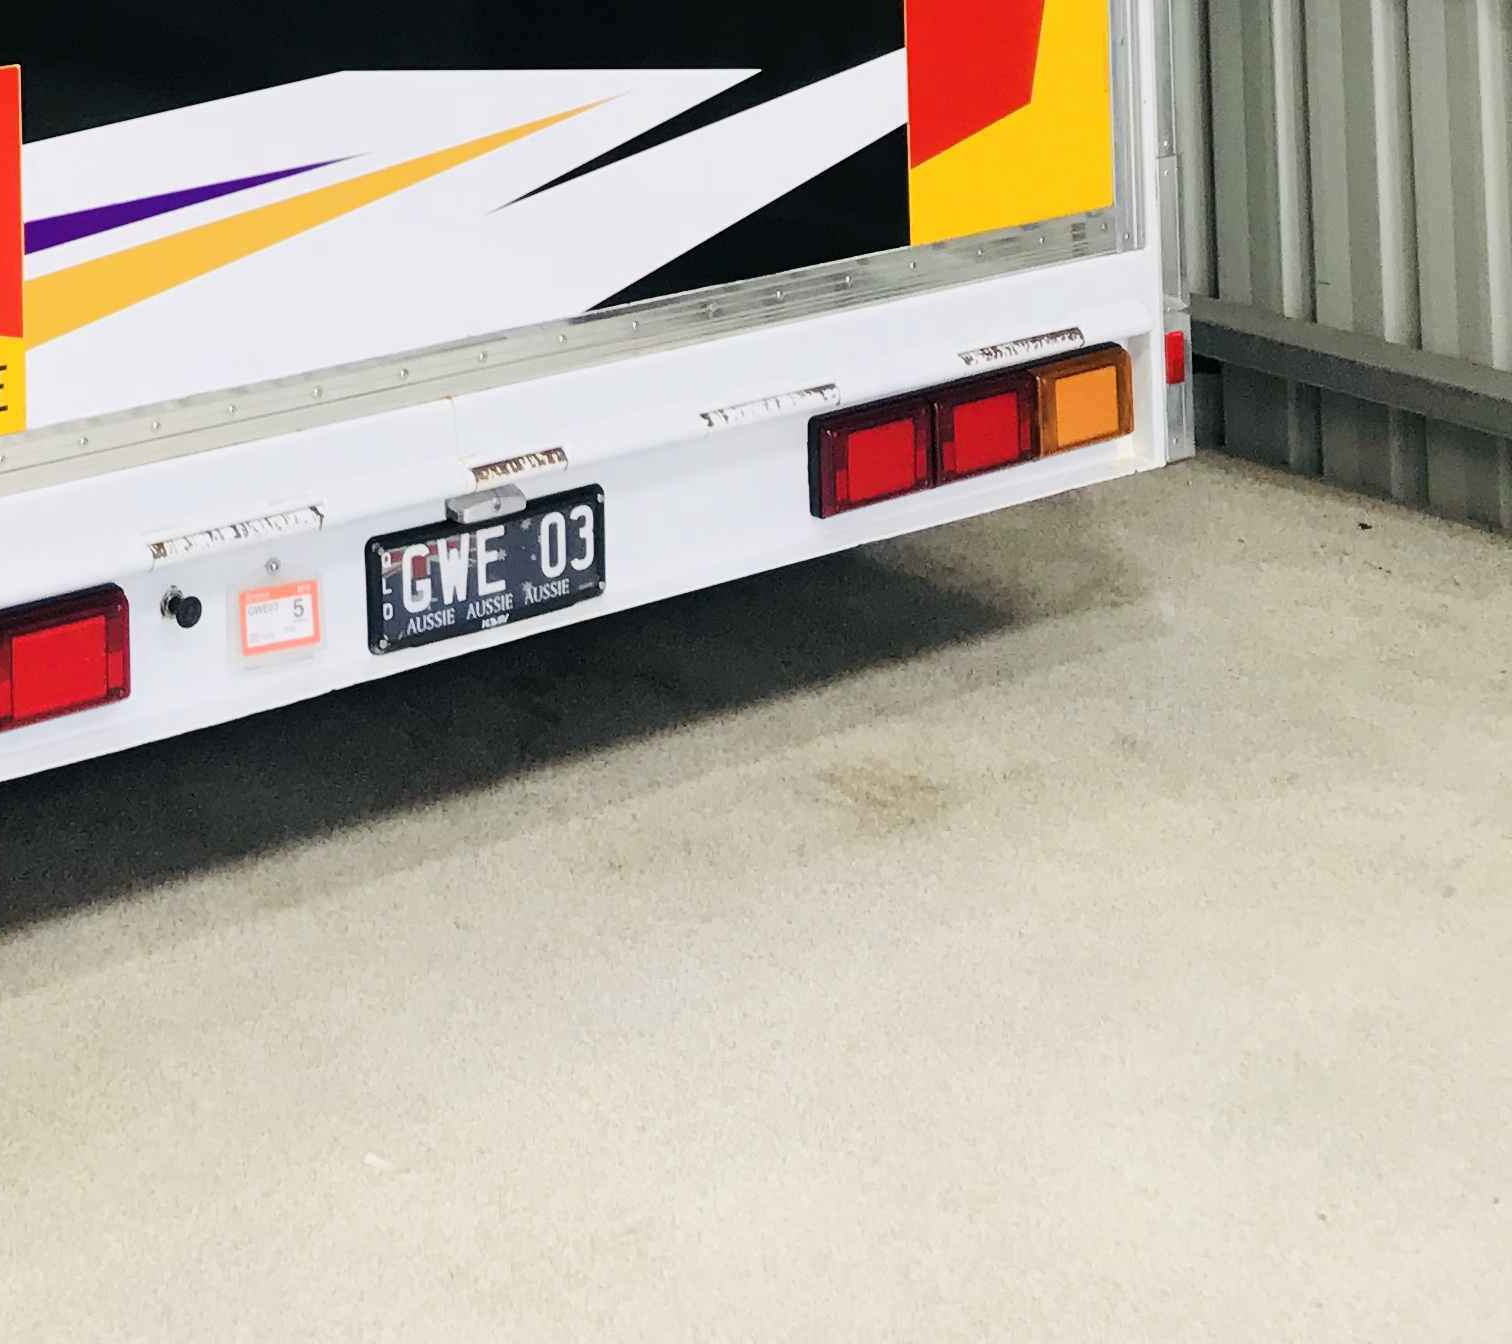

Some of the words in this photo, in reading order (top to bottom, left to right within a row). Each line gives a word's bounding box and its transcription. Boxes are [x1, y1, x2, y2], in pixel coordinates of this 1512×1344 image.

[401, 524, 507, 614] GWE
[540, 504, 595, 579] 03
[292, 598, 305, 618] 5
[406, 608, 456, 636] AUSSIE
[465, 593, 514, 620] AUSSIE
[523, 578, 571, 606] AUSSIE
